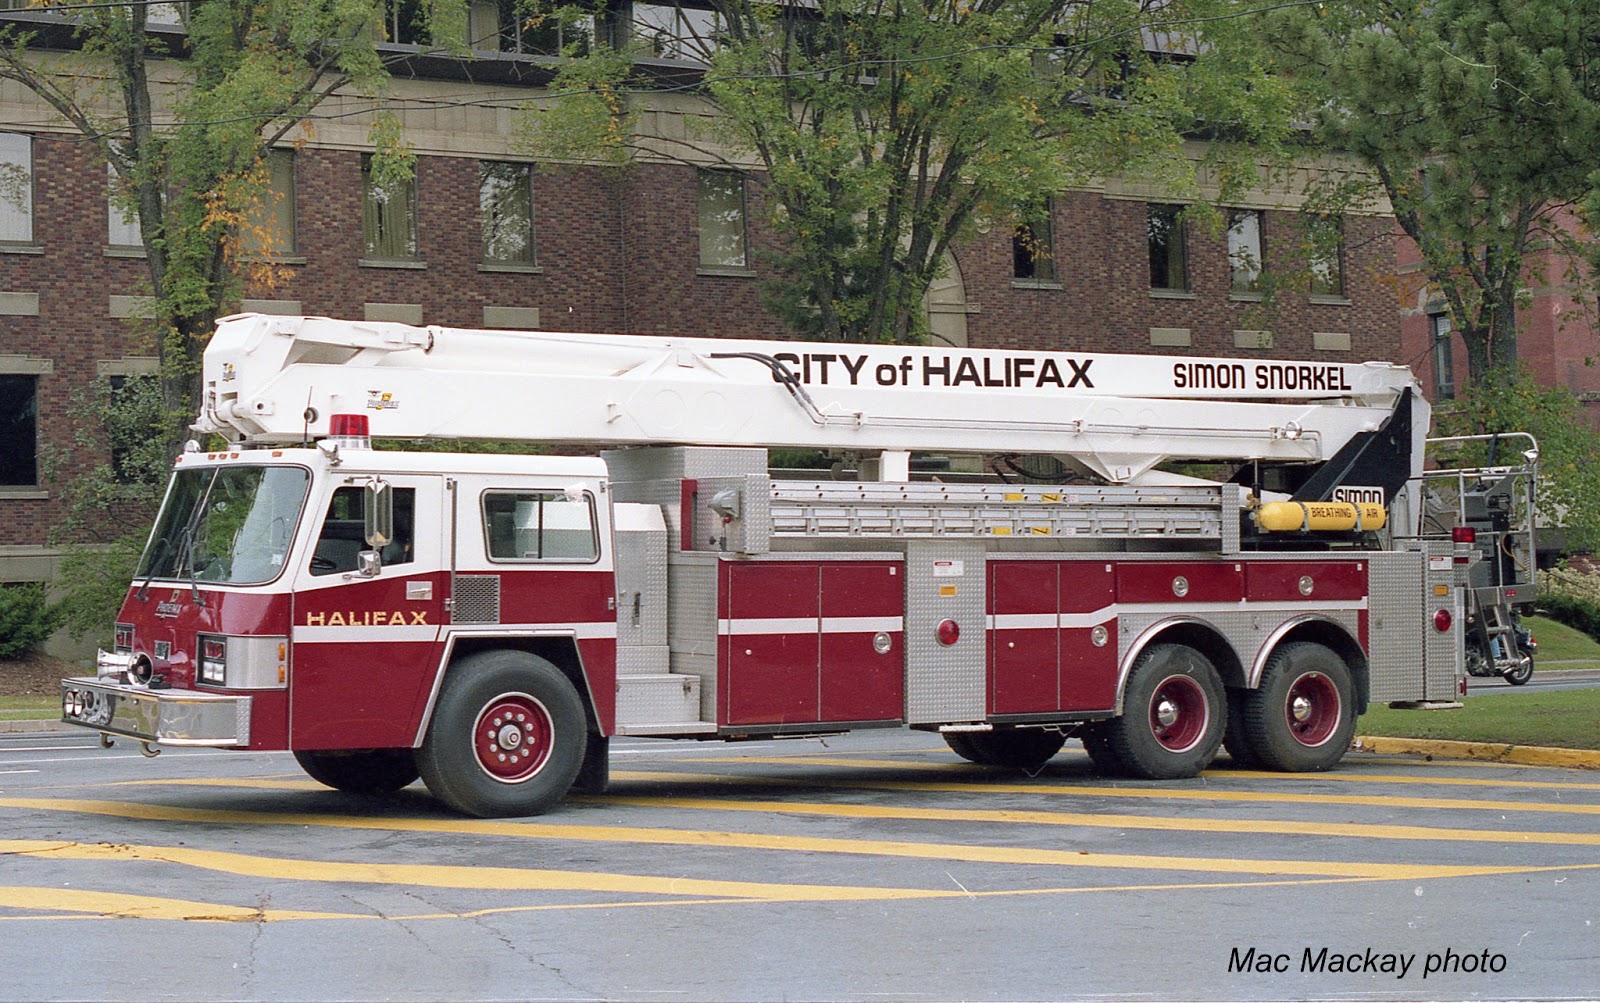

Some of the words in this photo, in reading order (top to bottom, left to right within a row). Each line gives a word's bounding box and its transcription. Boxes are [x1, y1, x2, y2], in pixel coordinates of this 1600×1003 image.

[772, 353, 869, 385] CITY
[876, 356, 912, 386] of
[923, 356, 1094, 388] HALIFAX
[1174, 363, 1246, 390] SIMON
[1255, 365, 1351, 391] SNORKEL
[1311, 506, 1352, 518] BREATHING
[1366, 508, 1379, 518] AIR
[306, 611, 428, 626] HALIFAX
